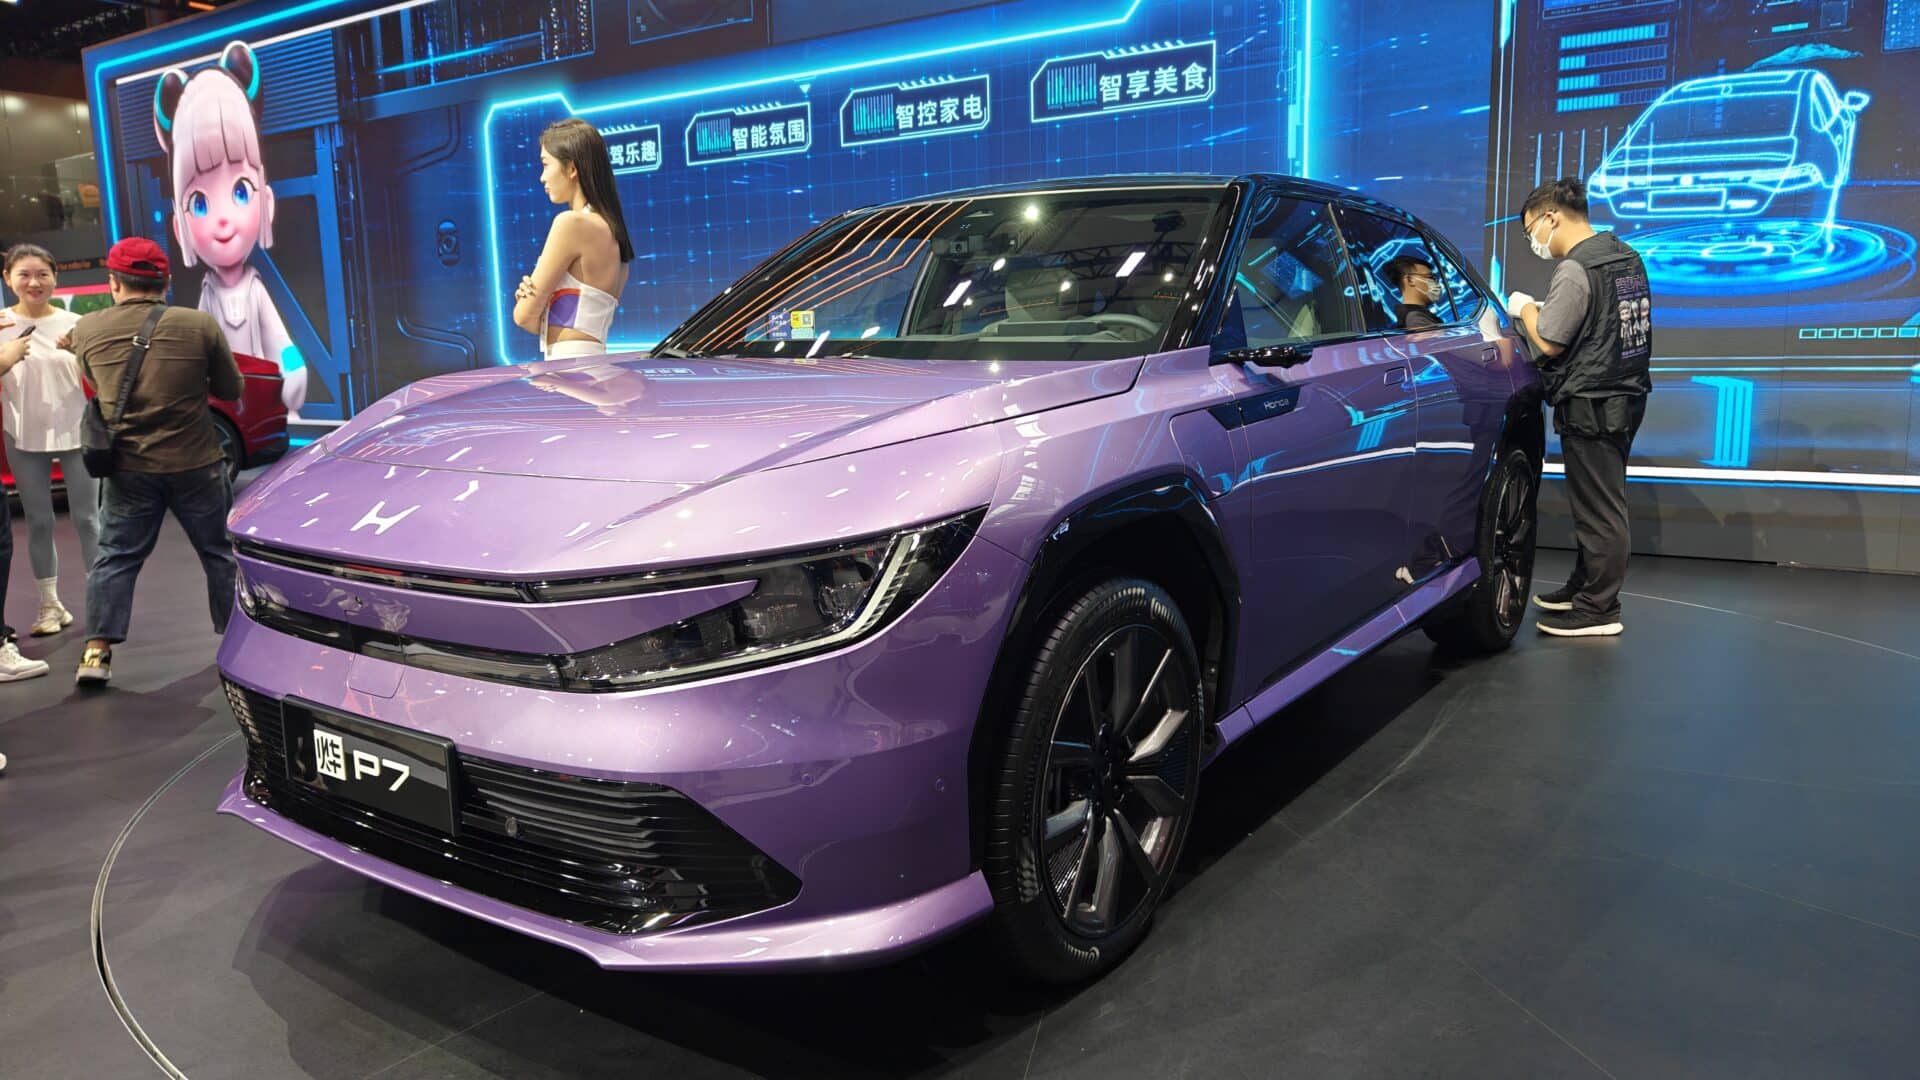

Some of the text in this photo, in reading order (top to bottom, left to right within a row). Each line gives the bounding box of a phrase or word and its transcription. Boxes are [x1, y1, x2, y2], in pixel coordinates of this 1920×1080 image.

[1099, 63, 1208, 102] 智享美食
[895, 94, 984, 129] 智控家电
[732, 118, 805, 150] 智能氛围
[353, 749, 410, 792] P7
